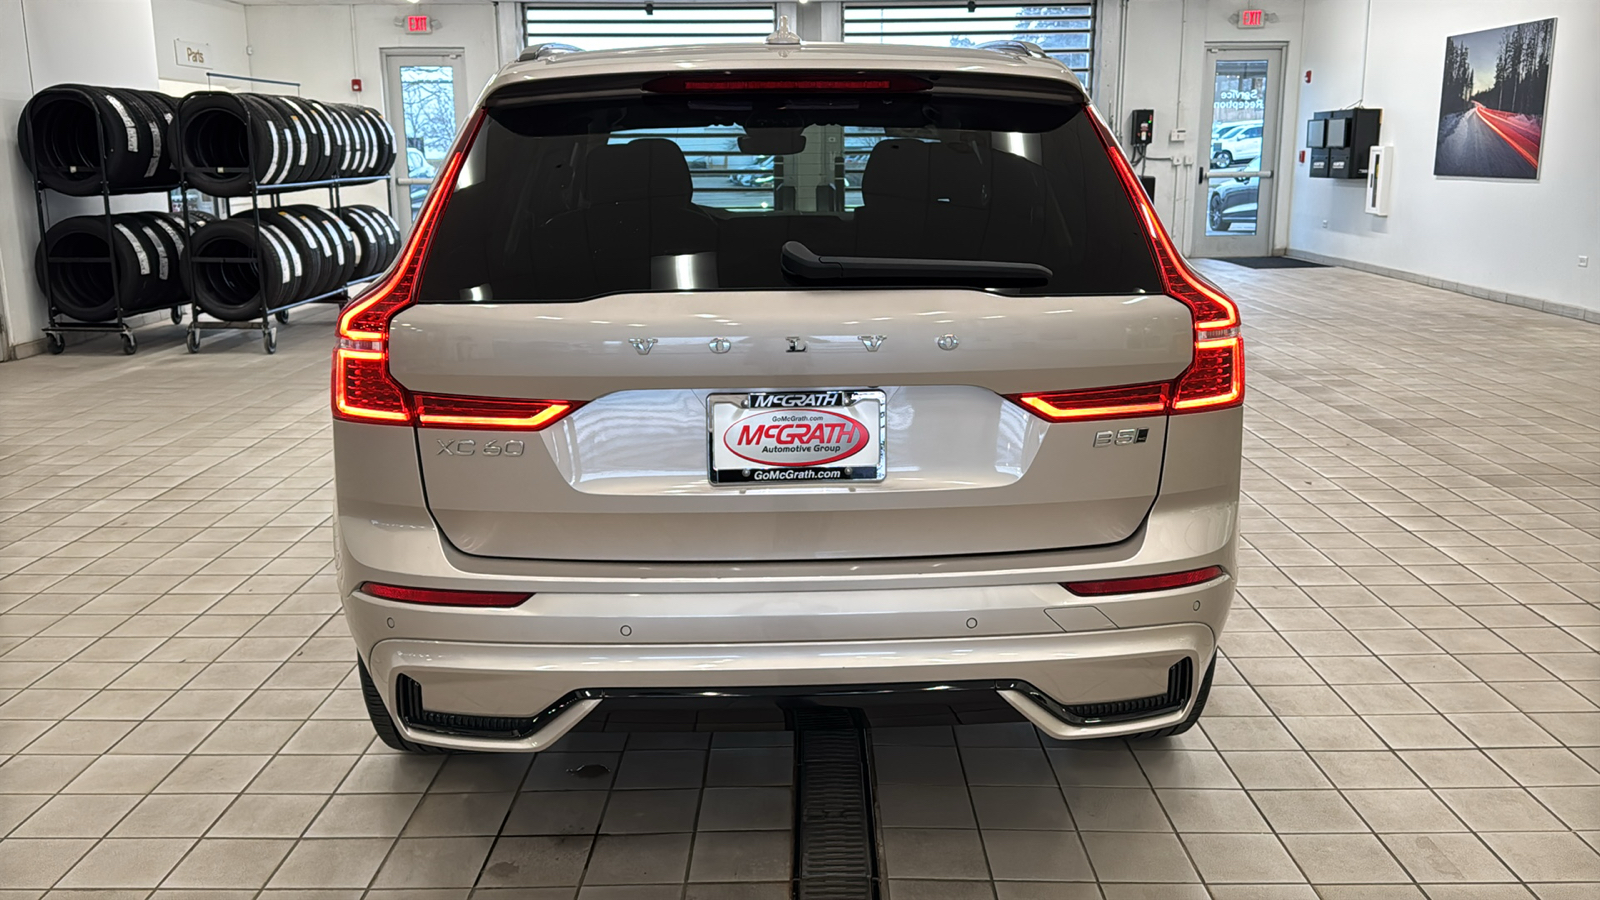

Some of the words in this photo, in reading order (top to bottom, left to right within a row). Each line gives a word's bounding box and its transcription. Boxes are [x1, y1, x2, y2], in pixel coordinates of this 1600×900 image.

[408, 16, 427, 31] EXIT
[1243, 10, 1262, 25] EXIT
[187, 47, 204, 63] Parts
[628, 334, 959, 355] VOLVO
[761, 445, 811, 454] Automotive
[814, 445, 841, 454] Group
[754, 470, 841, 480] GoMcGrath.com
